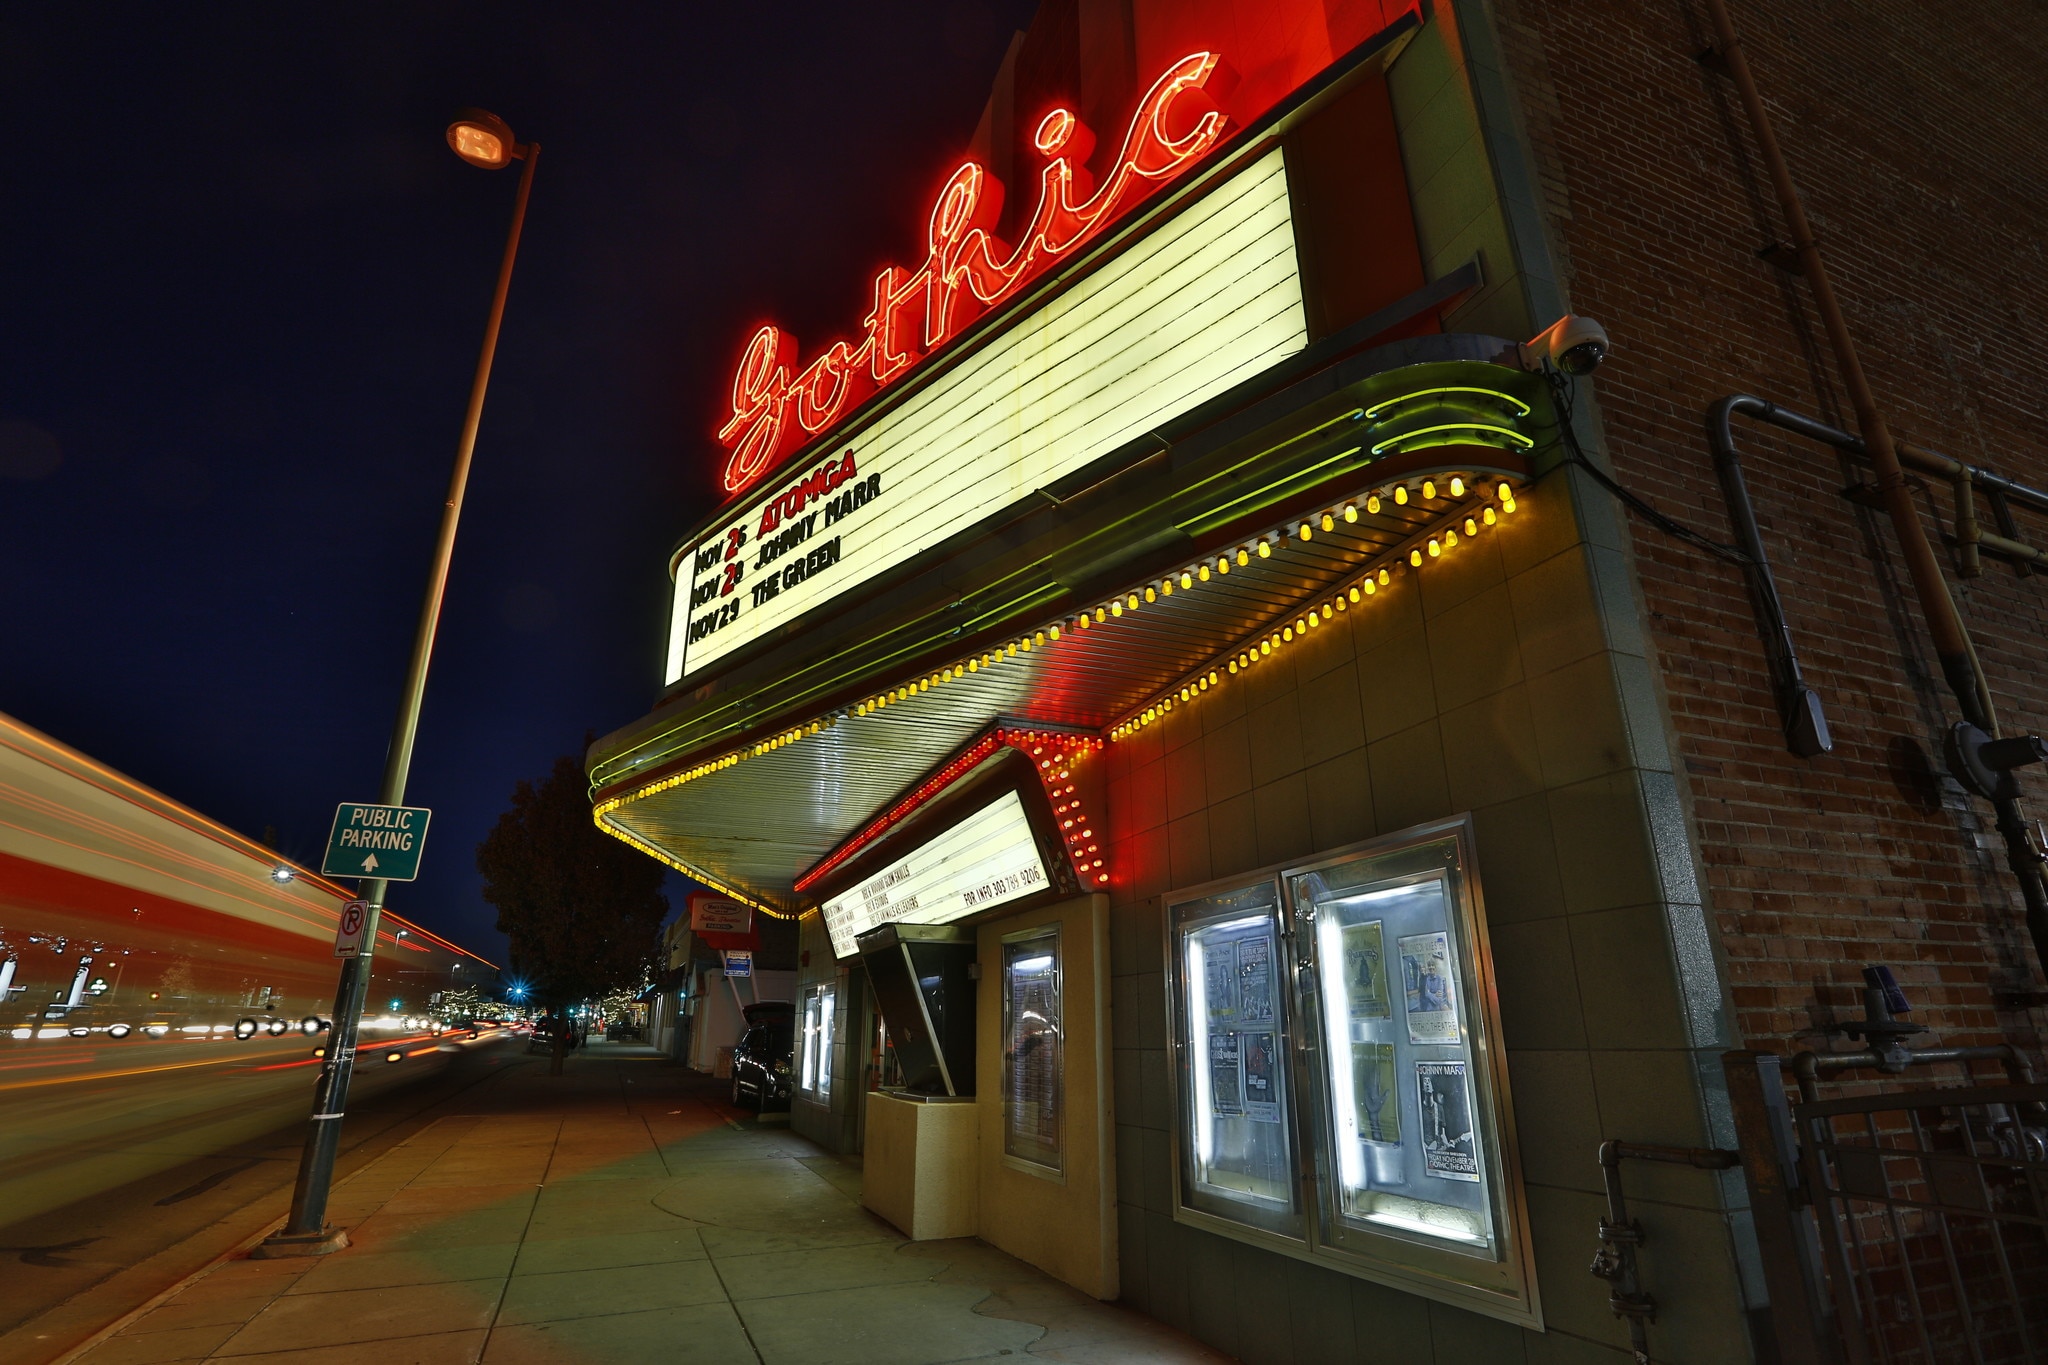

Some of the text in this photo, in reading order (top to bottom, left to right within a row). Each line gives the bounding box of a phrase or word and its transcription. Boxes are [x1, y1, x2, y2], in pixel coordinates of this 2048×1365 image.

[697, 539, 724, 573] NOV
[756, 448, 857, 540] ATOMGA
[692, 574, 721, 609] NOV
[825, 472, 881, 528] MARR
[689, 535, 841, 645] NOV 29 THE GREEN
[350, 808, 413, 829] PUBLIC
[339, 828, 413, 851] PARKING
[963, 866, 1040, 906] FOR INFO 303 789 9206
[1430, 1021, 1457, 1032] THEATRE
[1450, 1163, 1476, 1173] THEATRE
